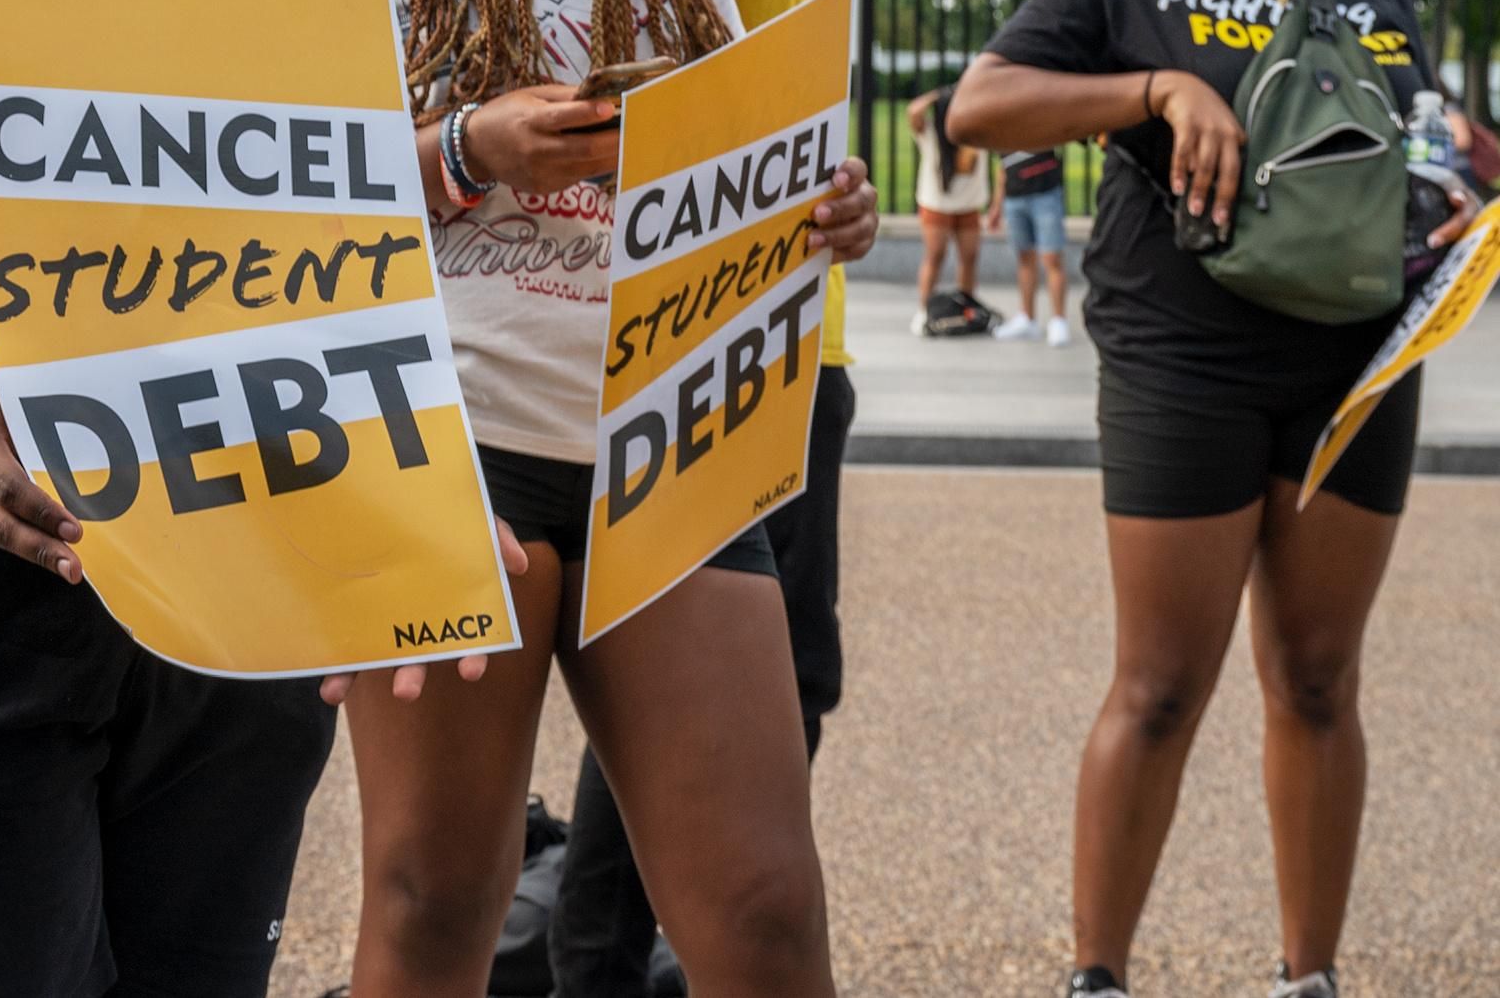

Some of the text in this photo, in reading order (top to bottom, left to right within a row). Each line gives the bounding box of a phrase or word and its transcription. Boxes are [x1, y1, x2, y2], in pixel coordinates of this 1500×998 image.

[625, 121, 836, 261] CANCEL
[19, 334, 433, 522] DEBT
[608, 275, 820, 529] DEBT
[753, 472, 798, 515] NAACP
[393, 614, 493, 648] NAACP
